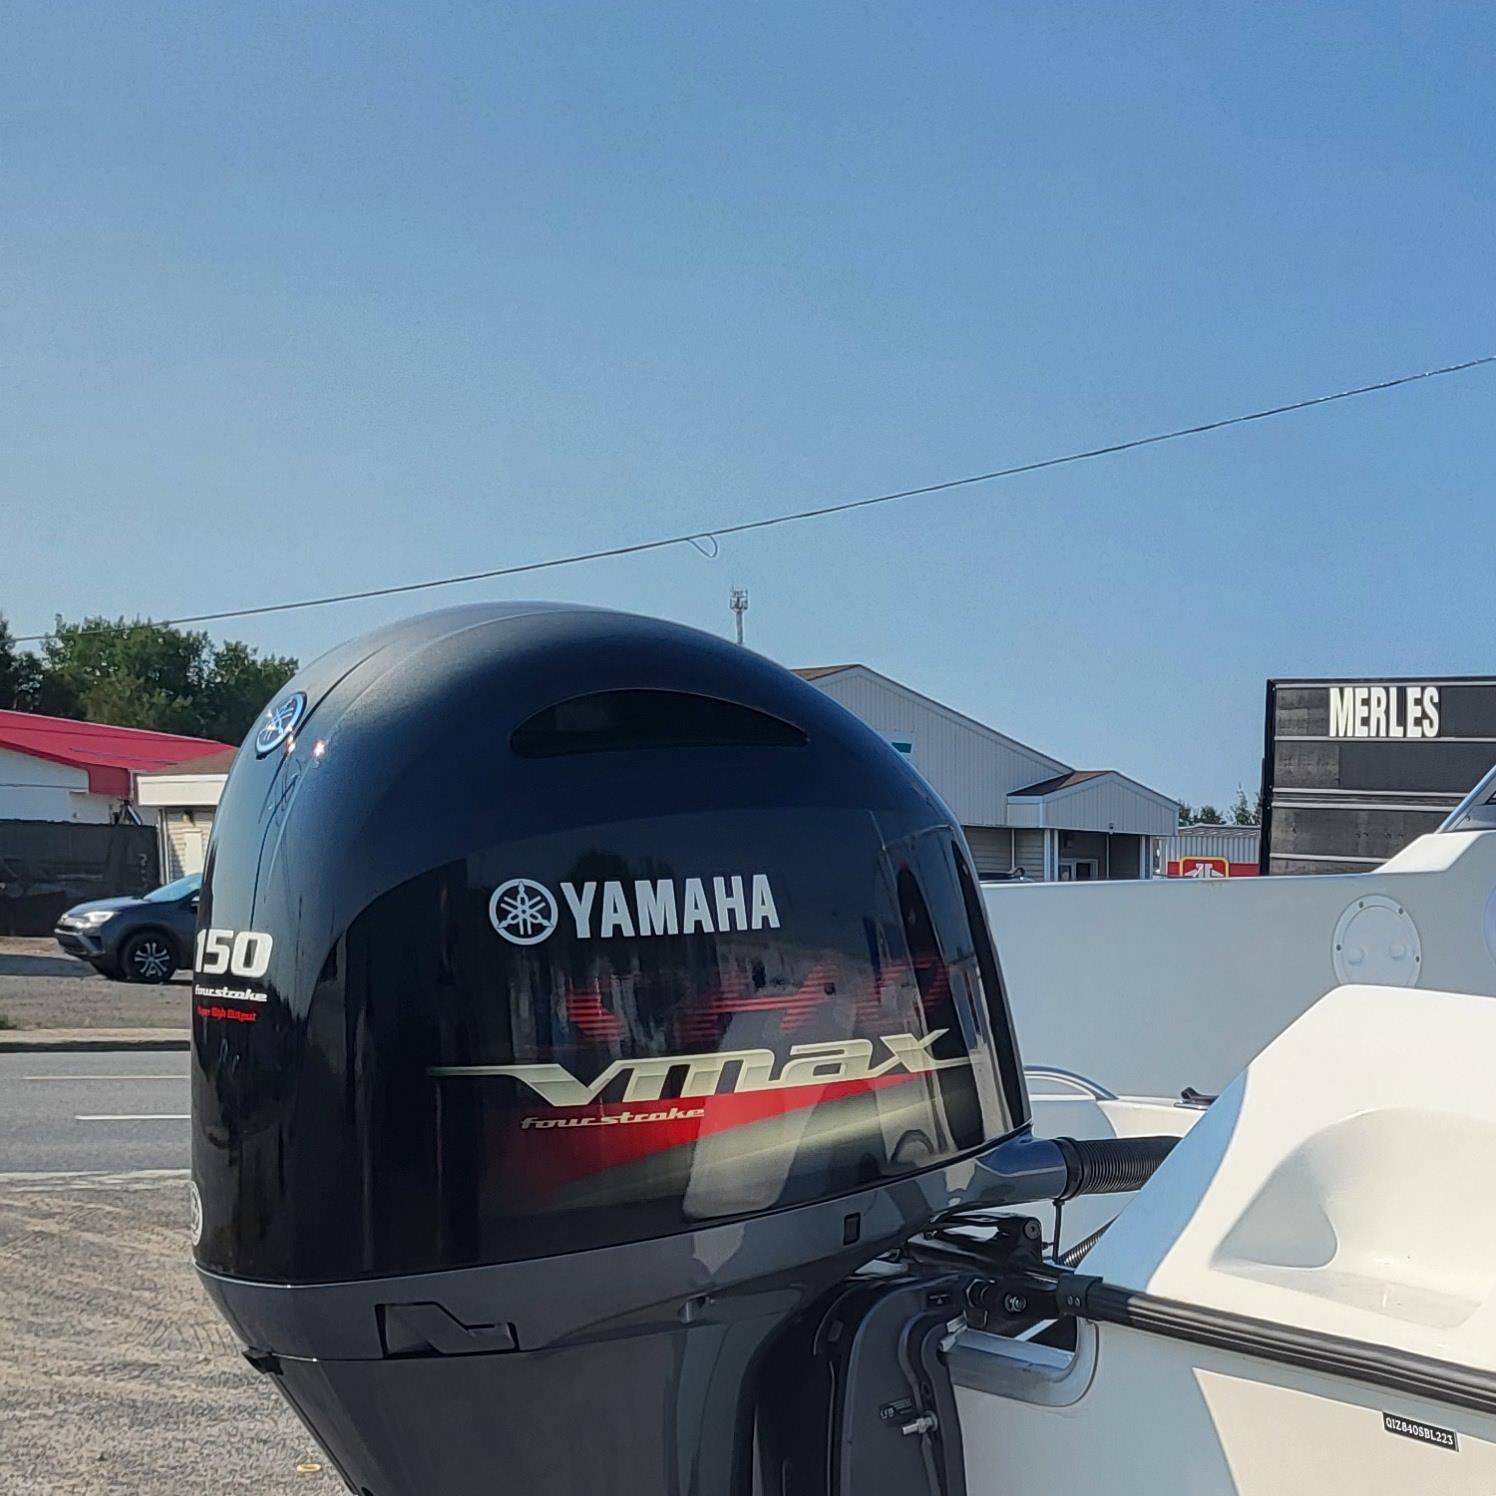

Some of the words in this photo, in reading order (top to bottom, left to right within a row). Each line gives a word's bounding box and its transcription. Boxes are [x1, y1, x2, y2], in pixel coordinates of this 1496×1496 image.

[1329, 686, 1439, 738] MERLES
[560, 873, 781, 940] YAMAHA
[195, 928, 273, 978] 150
